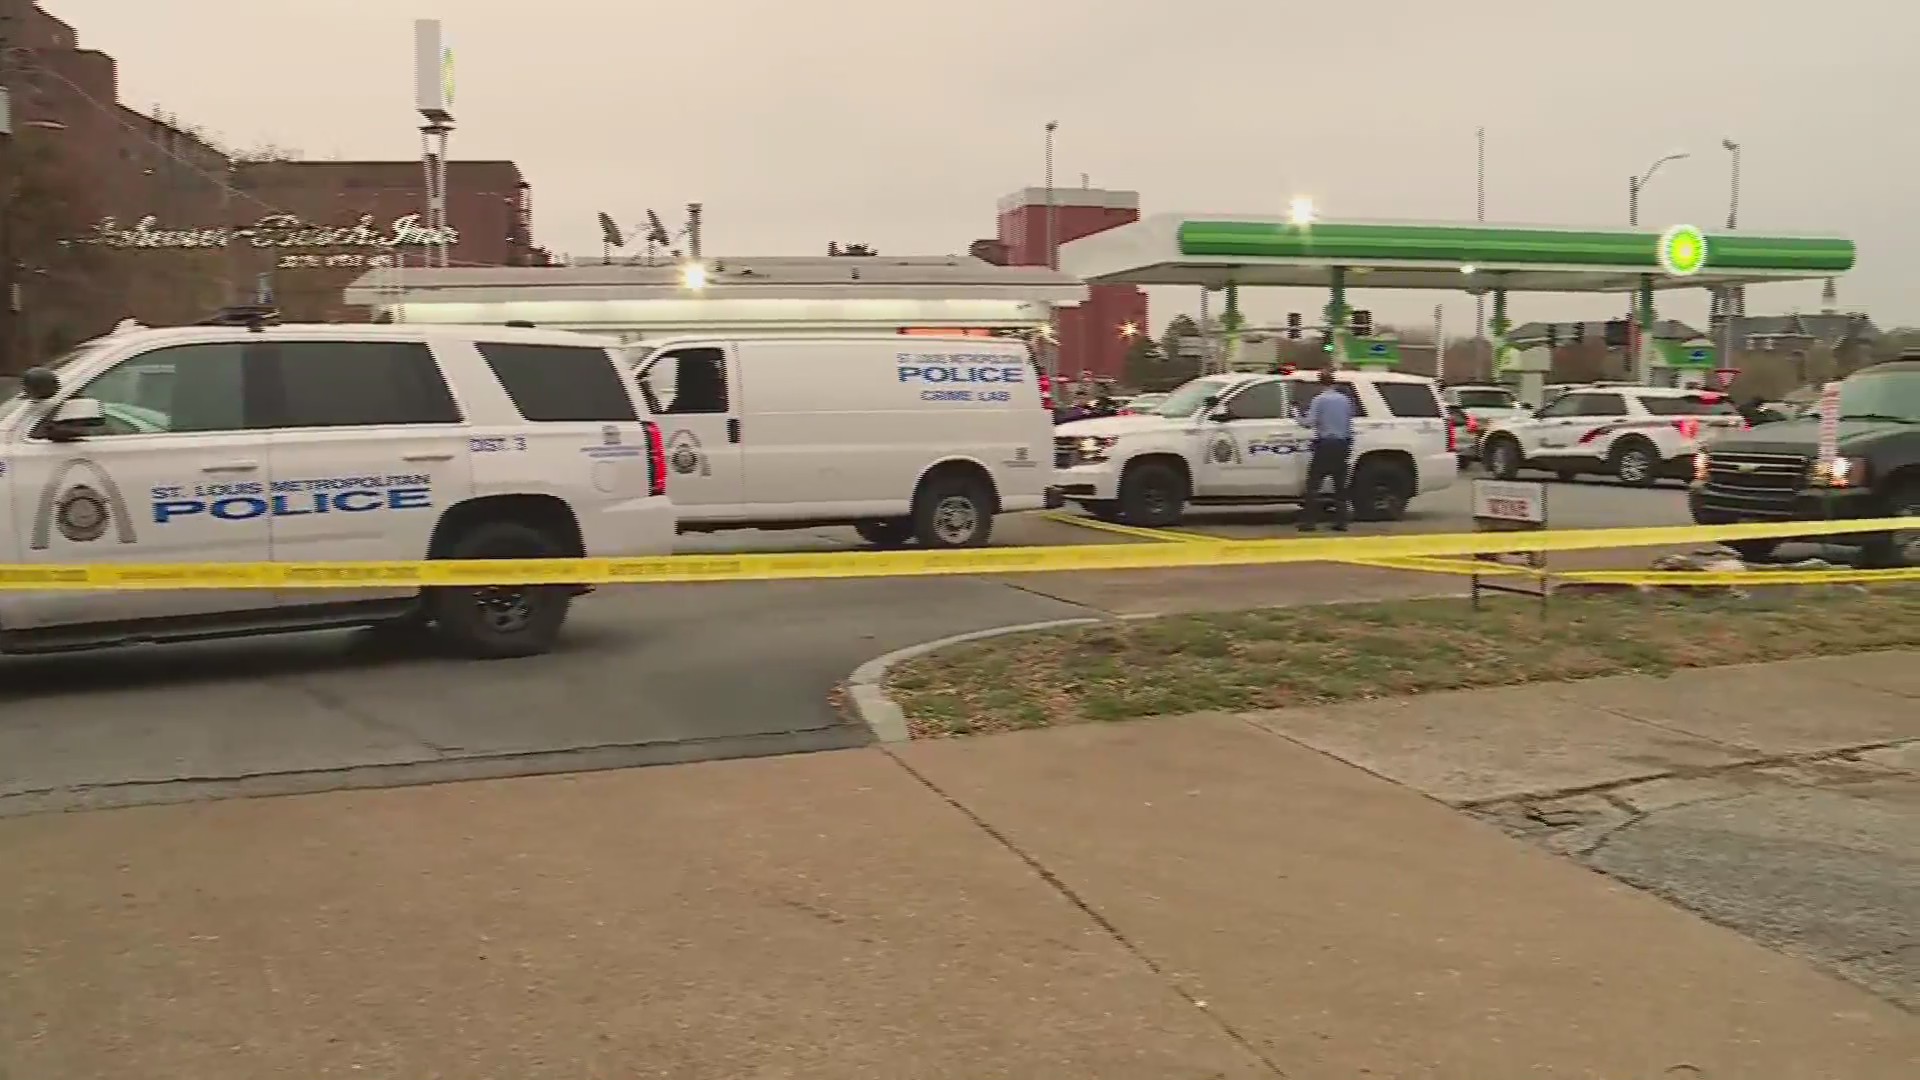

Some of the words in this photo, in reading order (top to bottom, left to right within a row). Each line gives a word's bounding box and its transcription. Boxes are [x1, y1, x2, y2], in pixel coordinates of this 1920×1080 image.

[898, 366, 1025, 383] POLICE
[920, 389, 973, 401] CRIME
[978, 389, 1011, 401] LAB
[512, 436, 527, 451] 3
[152, 485, 188, 500] ST.
[196, 481, 264, 497] LOUIS
[270, 473, 432, 493] METROPOLITAN
[153, 487, 433, 523] POLICE
